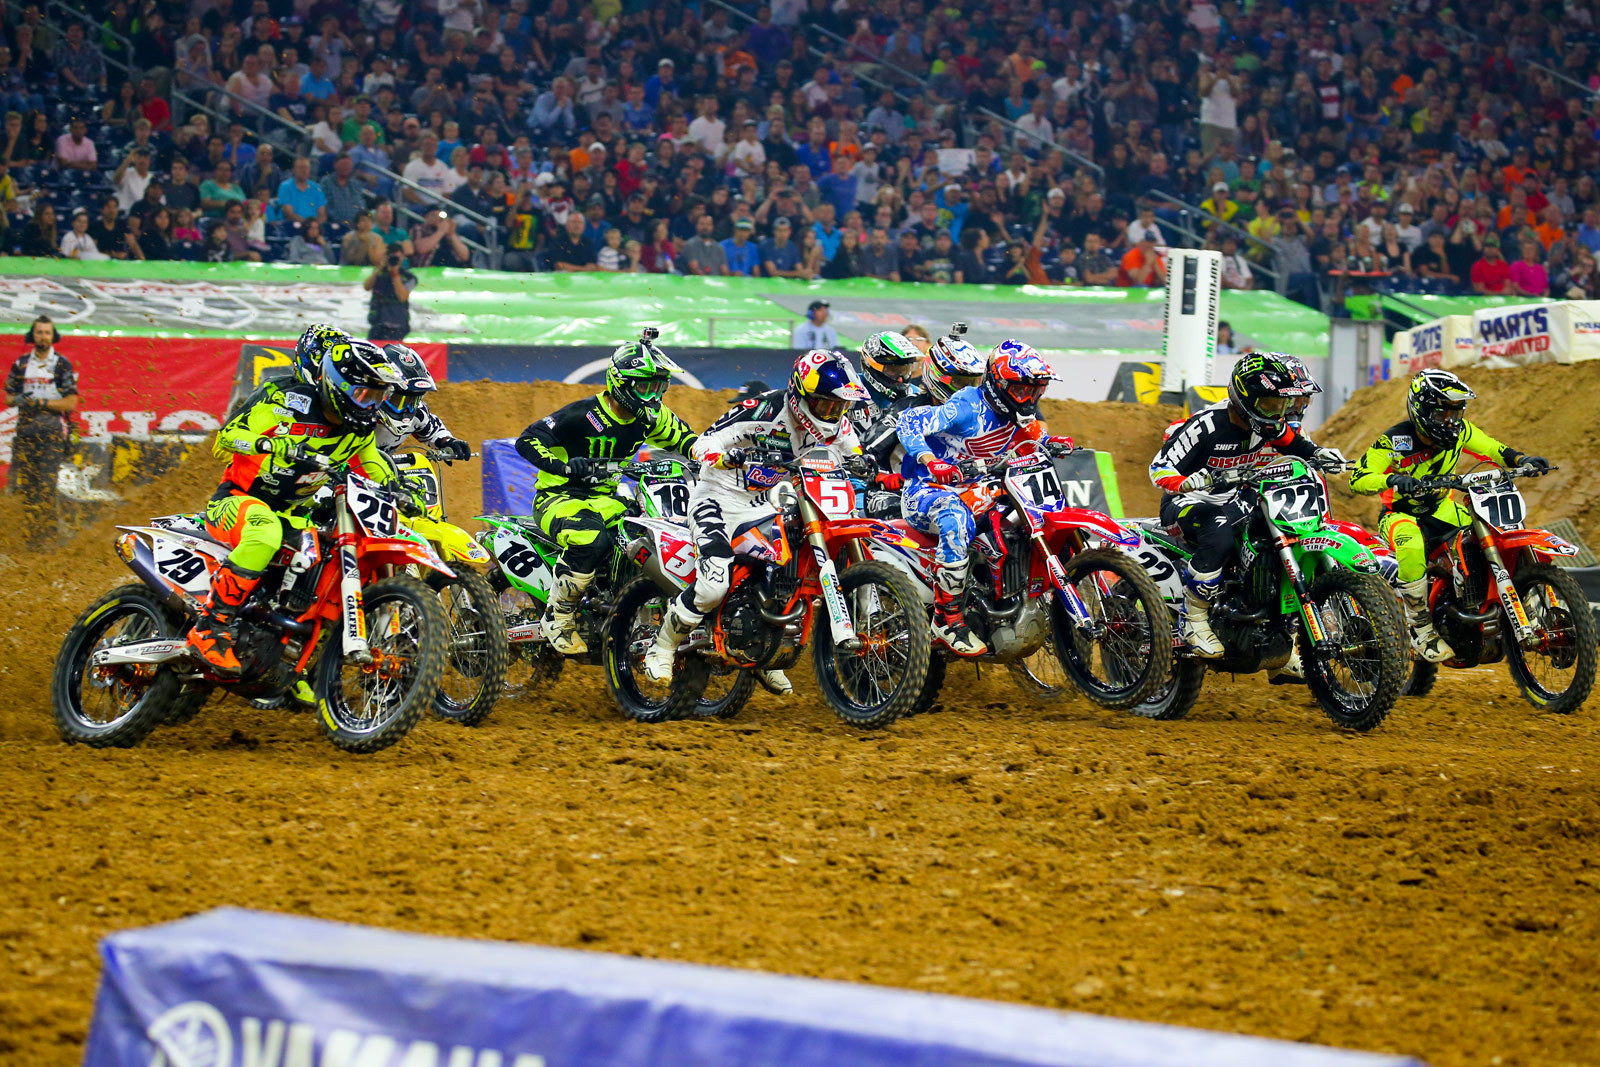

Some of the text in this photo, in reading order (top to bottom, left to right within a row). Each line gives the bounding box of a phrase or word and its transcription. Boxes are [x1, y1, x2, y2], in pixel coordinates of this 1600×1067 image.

[1480, 307, 1548, 343] PARTS
[790, 396, 825, 441] Red Bull
[748, 468, 777, 484] Red
[1023, 472, 1062, 507] 14
[357, 493, 397, 536] 29
[653, 485, 690, 517] 18
[820, 481, 849, 514] 5
[1272, 484, 1318, 521] 22
[1481, 493, 1522, 527] 10
[157, 548, 206, 585] 29
[498, 541, 543, 578] 18
[665, 544, 697, 577] 5
[346, 595, 358, 638] GALFER
[1502, 593, 1520, 632] GALFER
